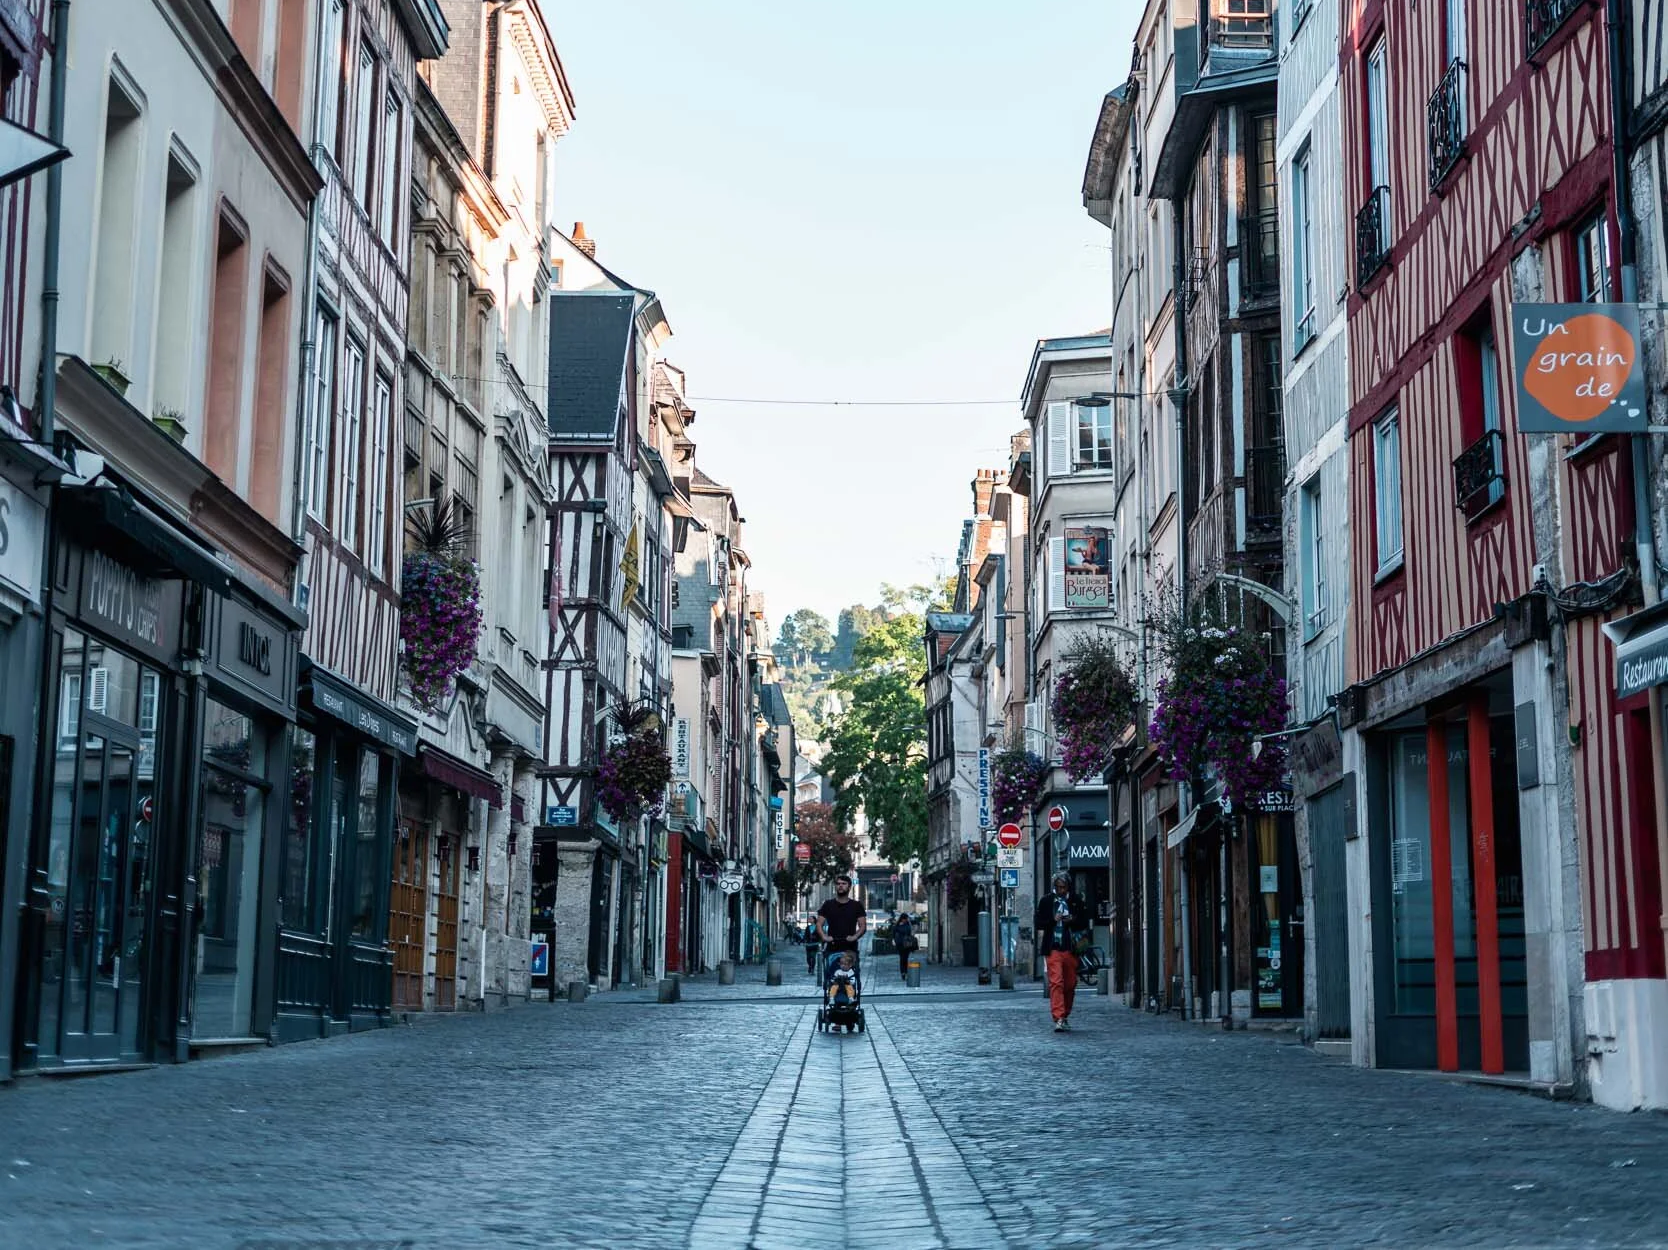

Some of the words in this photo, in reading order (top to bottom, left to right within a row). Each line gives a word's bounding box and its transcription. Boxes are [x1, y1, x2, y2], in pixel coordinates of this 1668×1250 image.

[1523, 318, 1569, 336] Un
[1537, 346, 1627, 373] grain
[1067, 579, 1107, 601] Burger
[137, 606, 158, 644] CHIPS
[1623, 657, 1668, 690] Restauran
[677, 719, 687, 768] RESTAURANT
[979, 749, 989, 827] PRESSING
[1070, 845, 1110, 859] MAXIM
